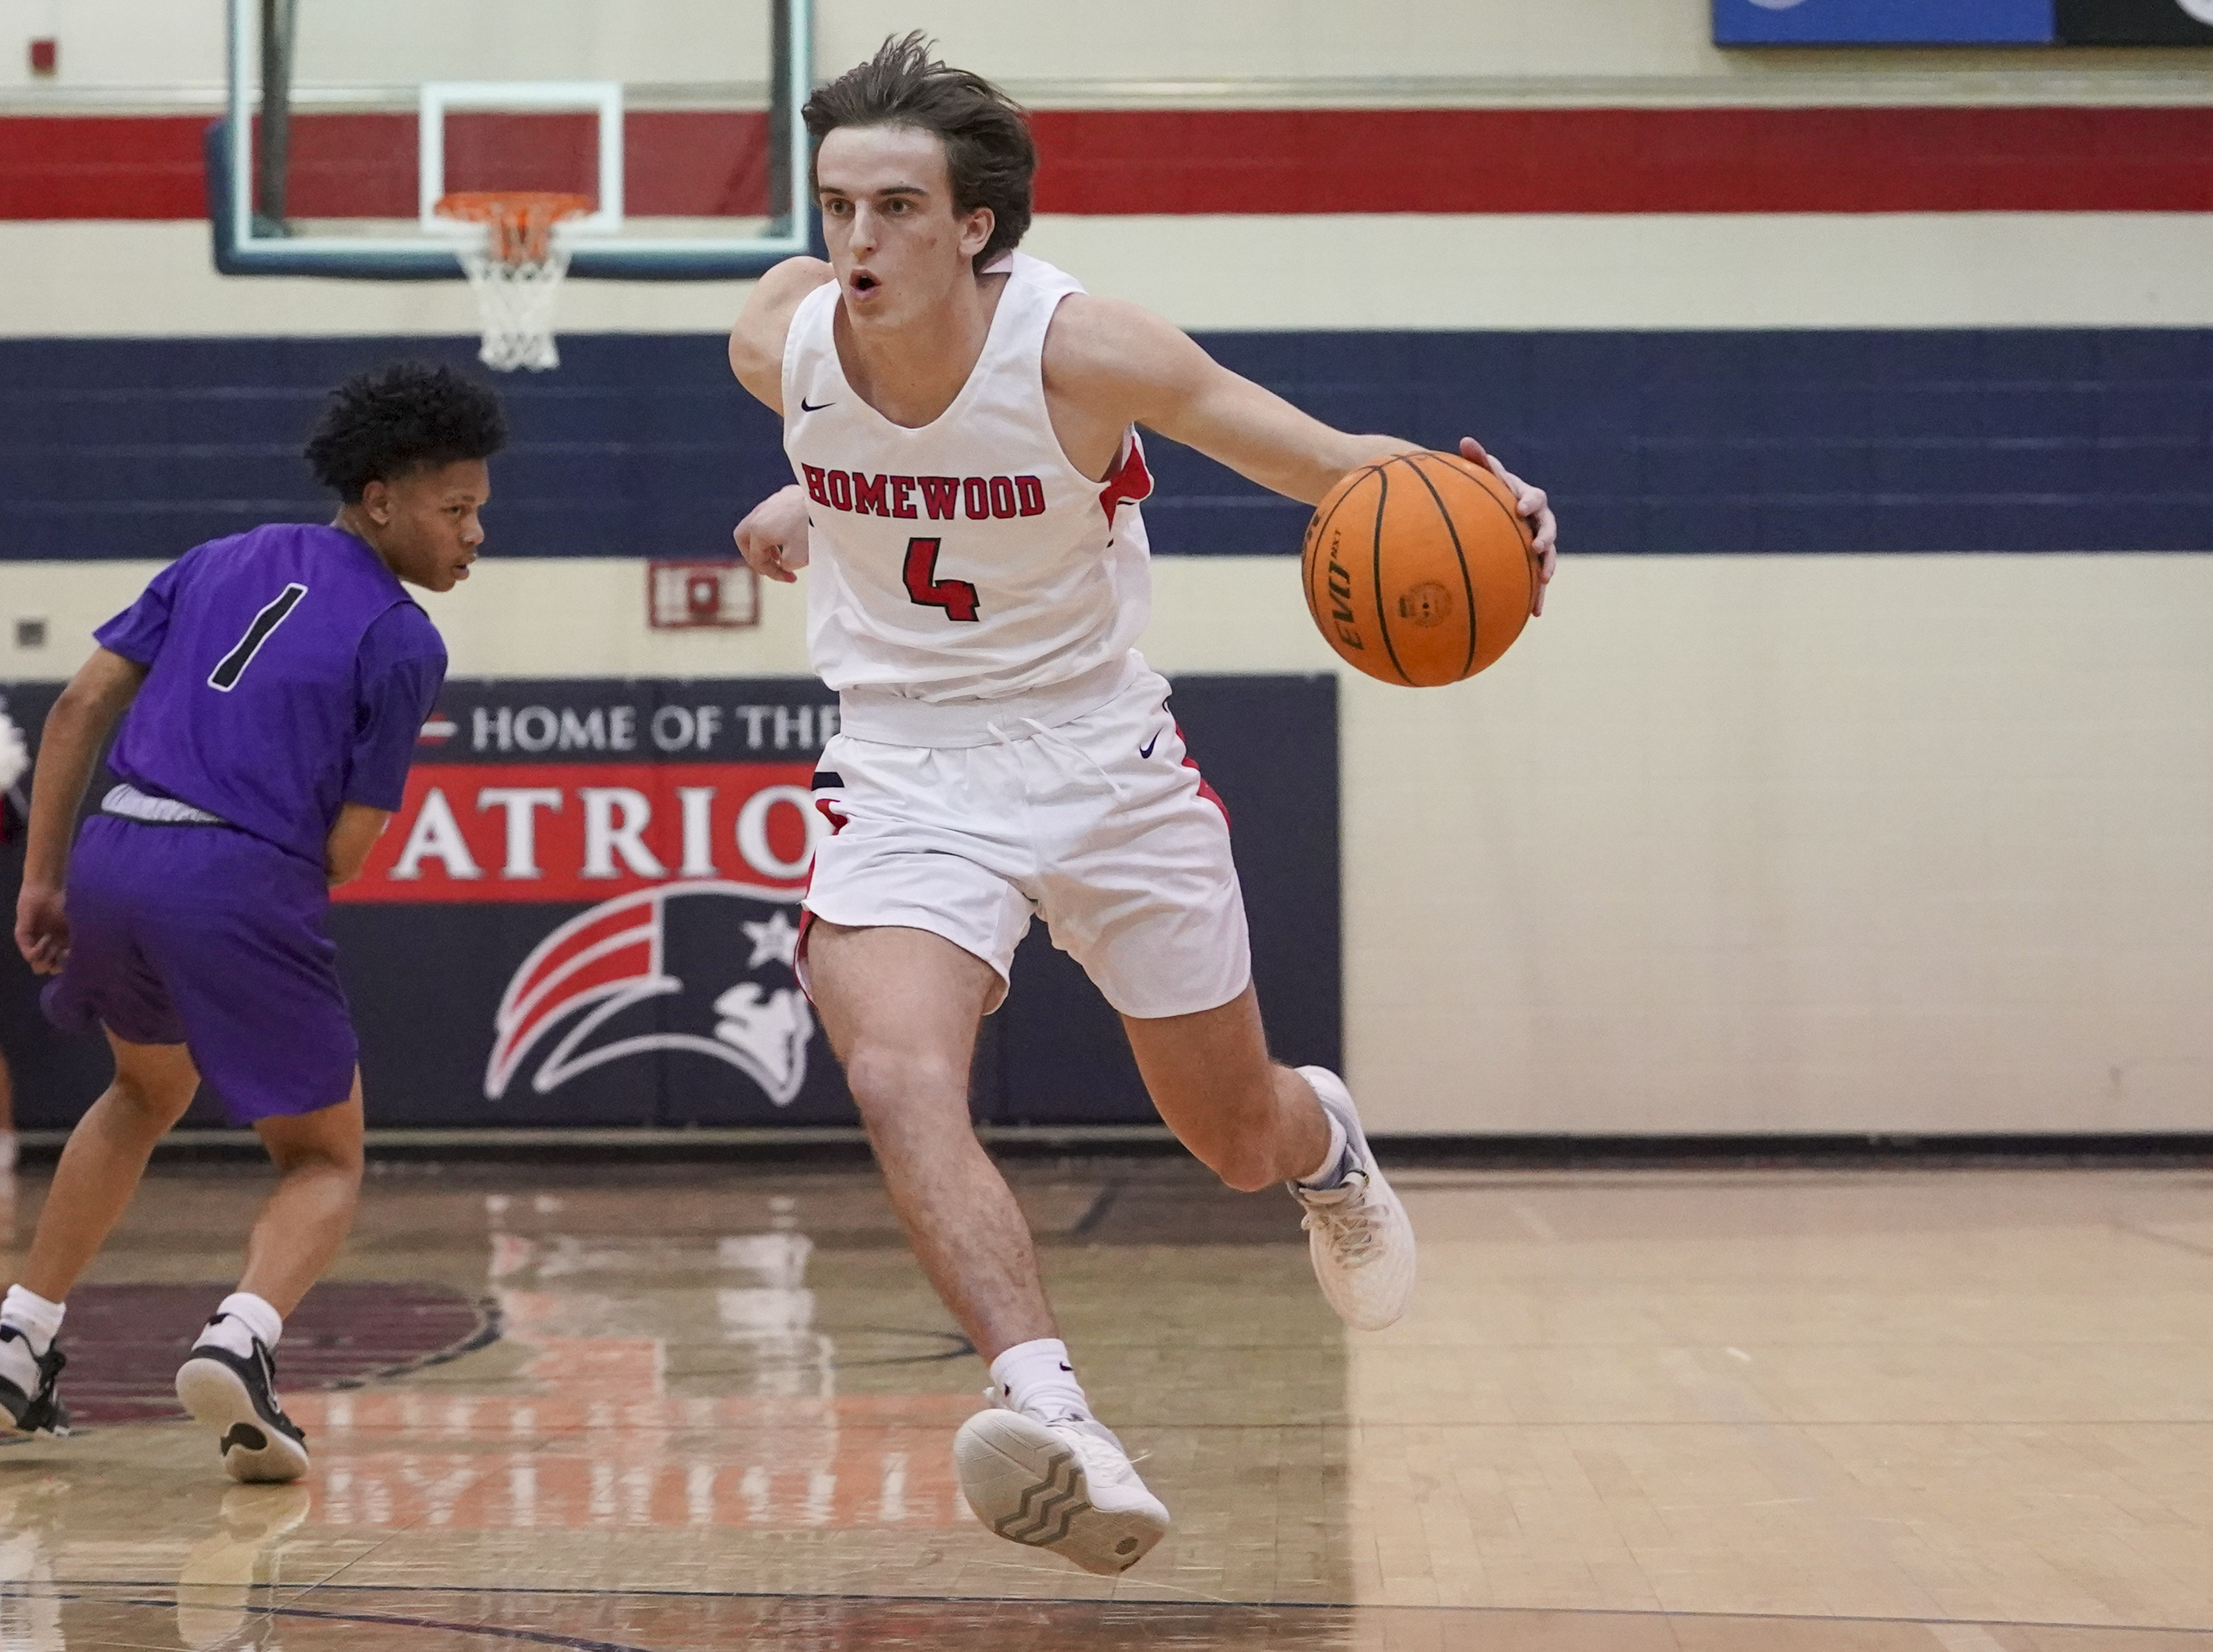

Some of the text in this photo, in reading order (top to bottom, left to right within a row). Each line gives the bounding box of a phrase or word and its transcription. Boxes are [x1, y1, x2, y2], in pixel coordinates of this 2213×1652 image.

[802, 462, 1046, 520] HOMEWOOD
[902, 537, 981, 622] 4
[1328, 561, 1365, 651] EVO
[207, 582, 308, 692] 1
[472, 704, 840, 752] HOME OF THE
[381, 783, 834, 879] ATRIO
